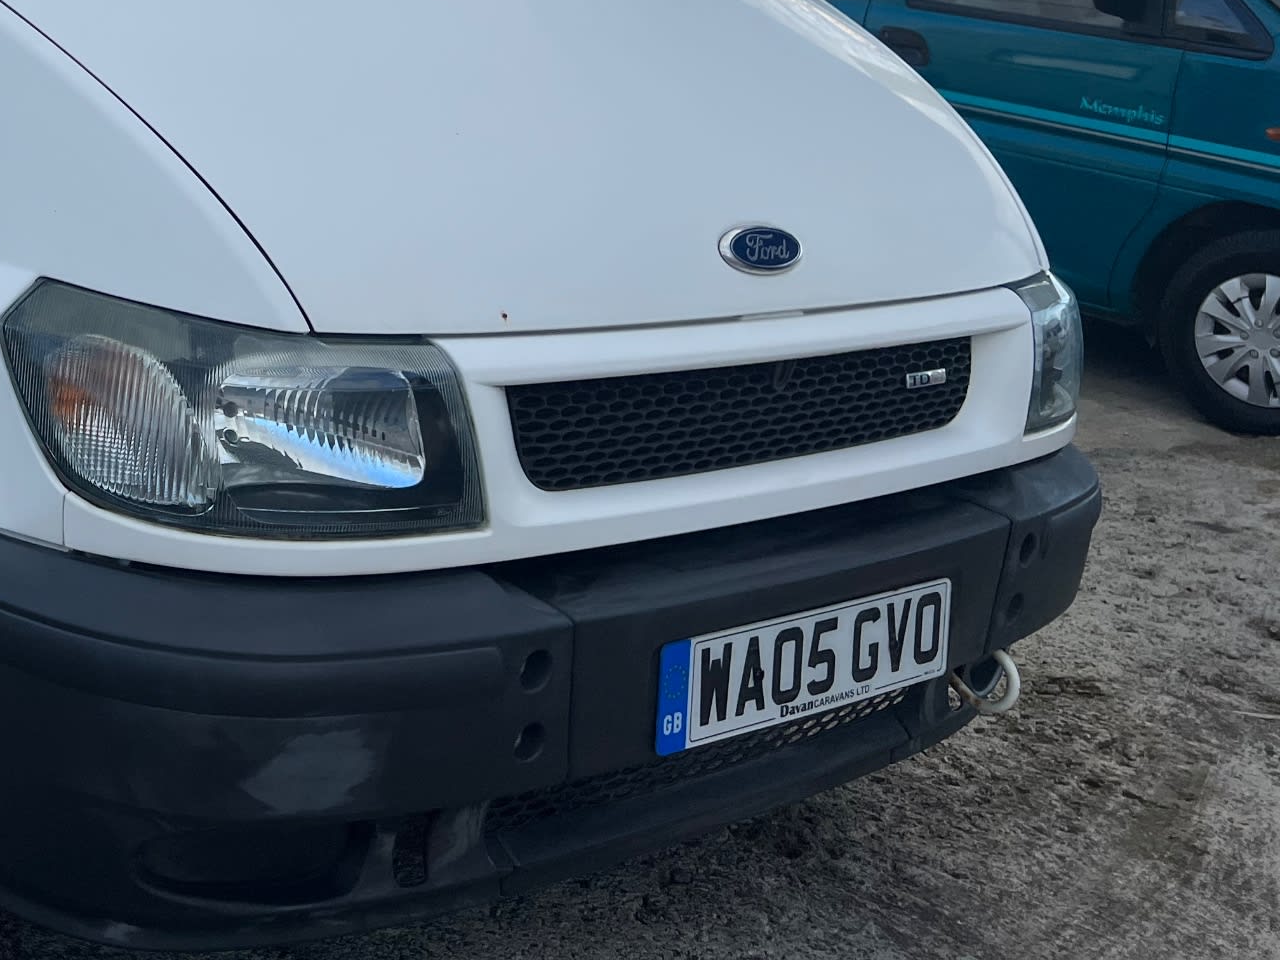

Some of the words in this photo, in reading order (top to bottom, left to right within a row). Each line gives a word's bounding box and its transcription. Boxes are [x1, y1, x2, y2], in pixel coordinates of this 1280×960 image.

[745, 233, 790, 262] Ford
[851, 591, 942, 683] GVO
[856, 684, 870, 696] LTD
[663, 711, 683, 736] GB
